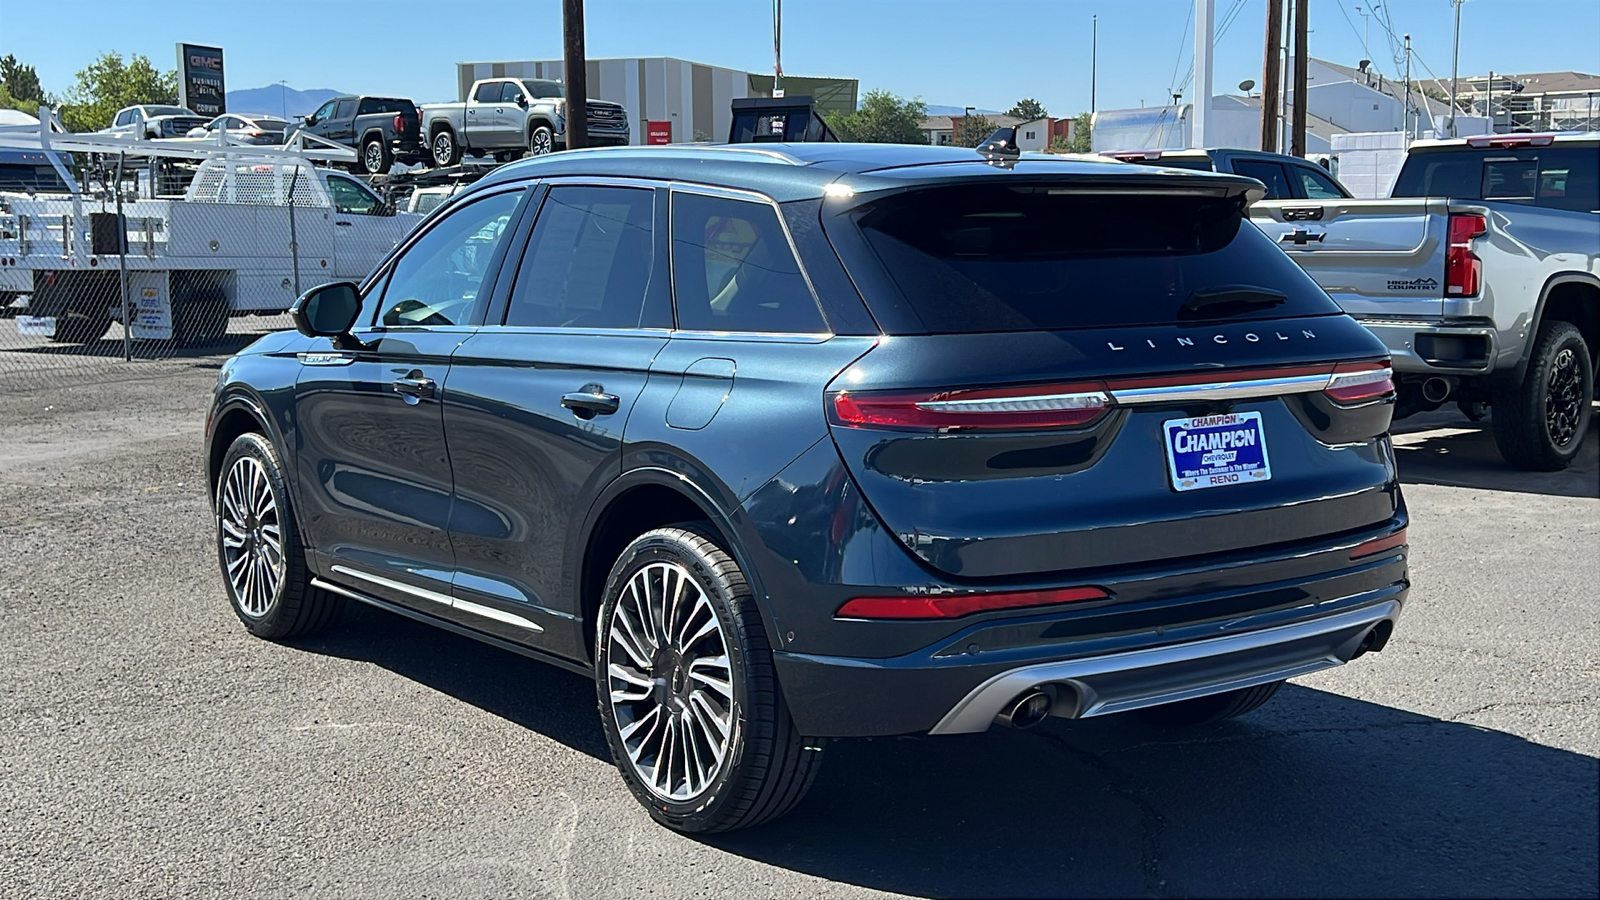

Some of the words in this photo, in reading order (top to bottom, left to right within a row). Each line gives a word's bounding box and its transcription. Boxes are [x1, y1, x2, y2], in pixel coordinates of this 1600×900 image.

[190, 55, 221, 69] GMC
[192, 77, 220, 87] BUSINESS
[197, 104, 219, 113] CORWIN
[1107, 329, 1317, 351] LINCOLN
[1192, 415, 1237, 427] CHAMPION
[1175, 429, 1255, 453] CHAMPION
[1203, 452, 1235, 462] CHEVROLET
[1210, 474, 1239, 485] RENO
